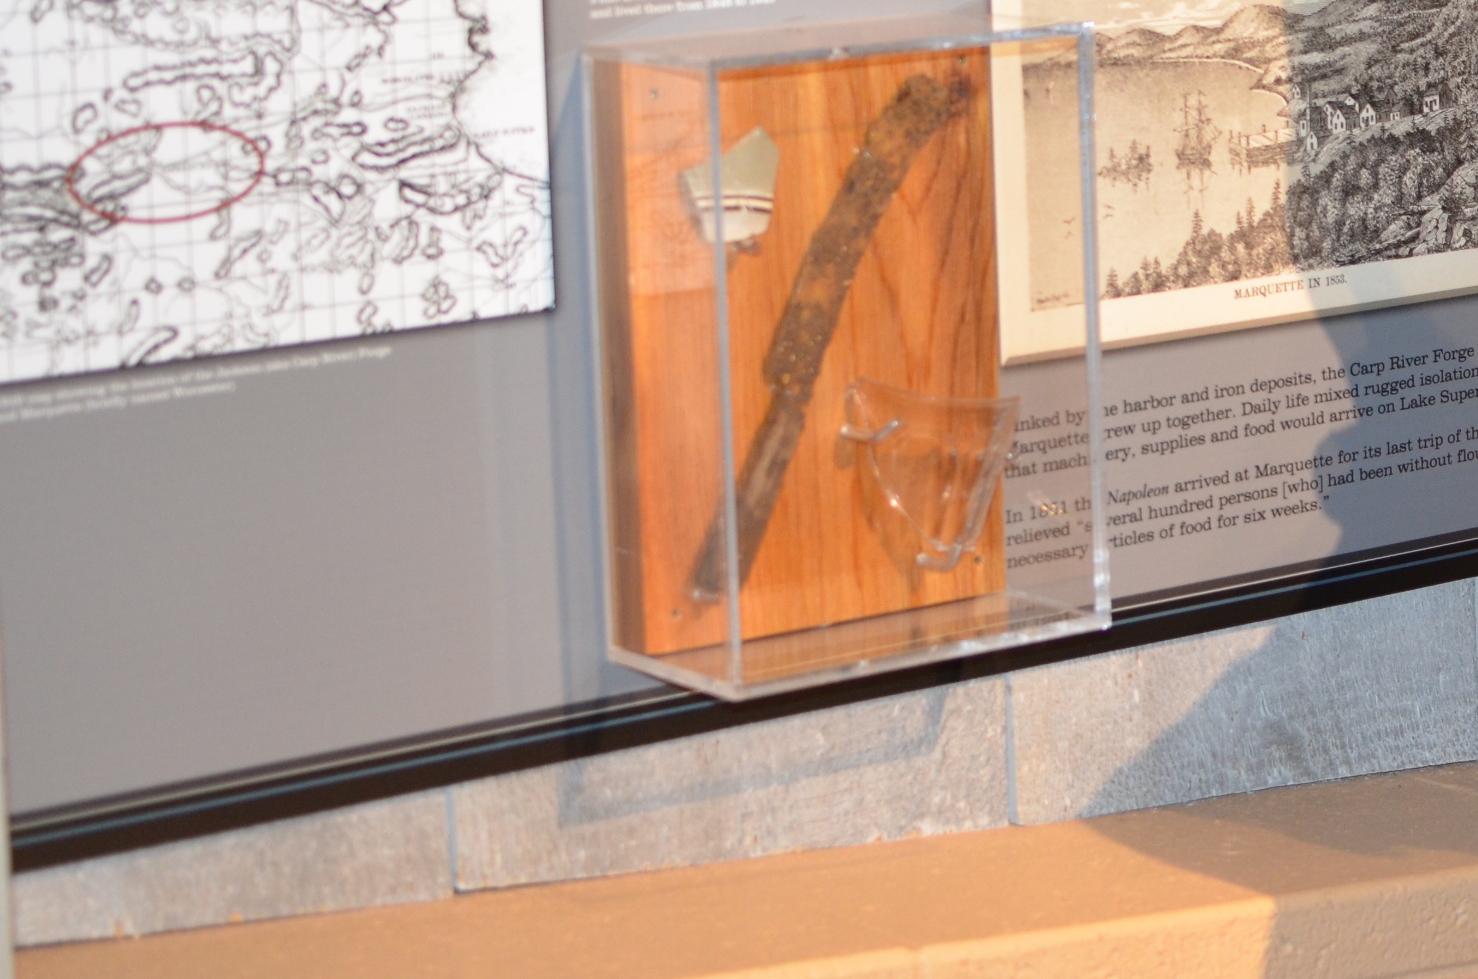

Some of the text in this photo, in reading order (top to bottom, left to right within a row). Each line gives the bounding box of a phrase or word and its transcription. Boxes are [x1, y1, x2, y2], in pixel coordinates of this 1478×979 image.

[1234, 274, 1348, 300] MARQUETTE IN 1853.
[1065, 409, 1086, 426] by
[1122, 395, 1177, 413] harbor
[1180, 386, 1210, 404] and
[1213, 384, 1246, 399] iron
[1248, 372, 1317, 393] deposits,
[1320, 366, 1346, 381] the
[1348, 361, 1385, 376] Carp
[1388, 354, 1429, 370] River
[1431, 346, 1475, 363] Forge
[1104, 424, 1136, 438] rew
[1140, 419, 1162, 435] up
[1164, 408, 1236, 430] together.
[1240, 397, 1282, 416] Daily
[1284, 392, 1310, 409] life
[1312, 383, 1360, 403] mixed
[1362, 374, 1416, 396] rugged
[1003, 461, 1036, 478] that
[1139, 434, 1206, 455] supplies
[1208, 425, 1240, 443] and
[1242, 418, 1276, 437] food
[1278, 410, 1326, 430] would
[1328, 405, 1374, 422] arrive
[1376, 402, 1396, 414] on
[1398, 393, 1436, 410] Lake
[1005, 508, 1024, 524] In
[1106, 483, 1170, 505] Napoleon
[1173, 470, 1230, 492] arrived
[1233, 468, 1250, 482] at
[1253, 455, 1334, 478] Marquette
[1336, 449, 1360, 464] for
[1362, 445, 1382, 459] its
[1385, 439, 1414, 455] last
[1416, 433, 1444, 450] trip
[1446, 428, 1462, 444] of
[1005, 522, 1072, 546] relieved
[1147, 495, 1214, 519] hundred
[1217, 486, 1278, 510] persons
[1281, 474, 1323, 499] [who]
[1326, 469, 1355, 487] had
[1358, 465, 1393, 481] been
[1396, 453, 1453, 473] without
[1005, 544, 1091, 568] necessary
[1157, 522, 1176, 539] of
[1178, 516, 1213, 535] food
[1215, 514, 1240, 528] for
[1242, 508, 1267, 523] six
[1268, 495, 1336, 517] weeks.”
